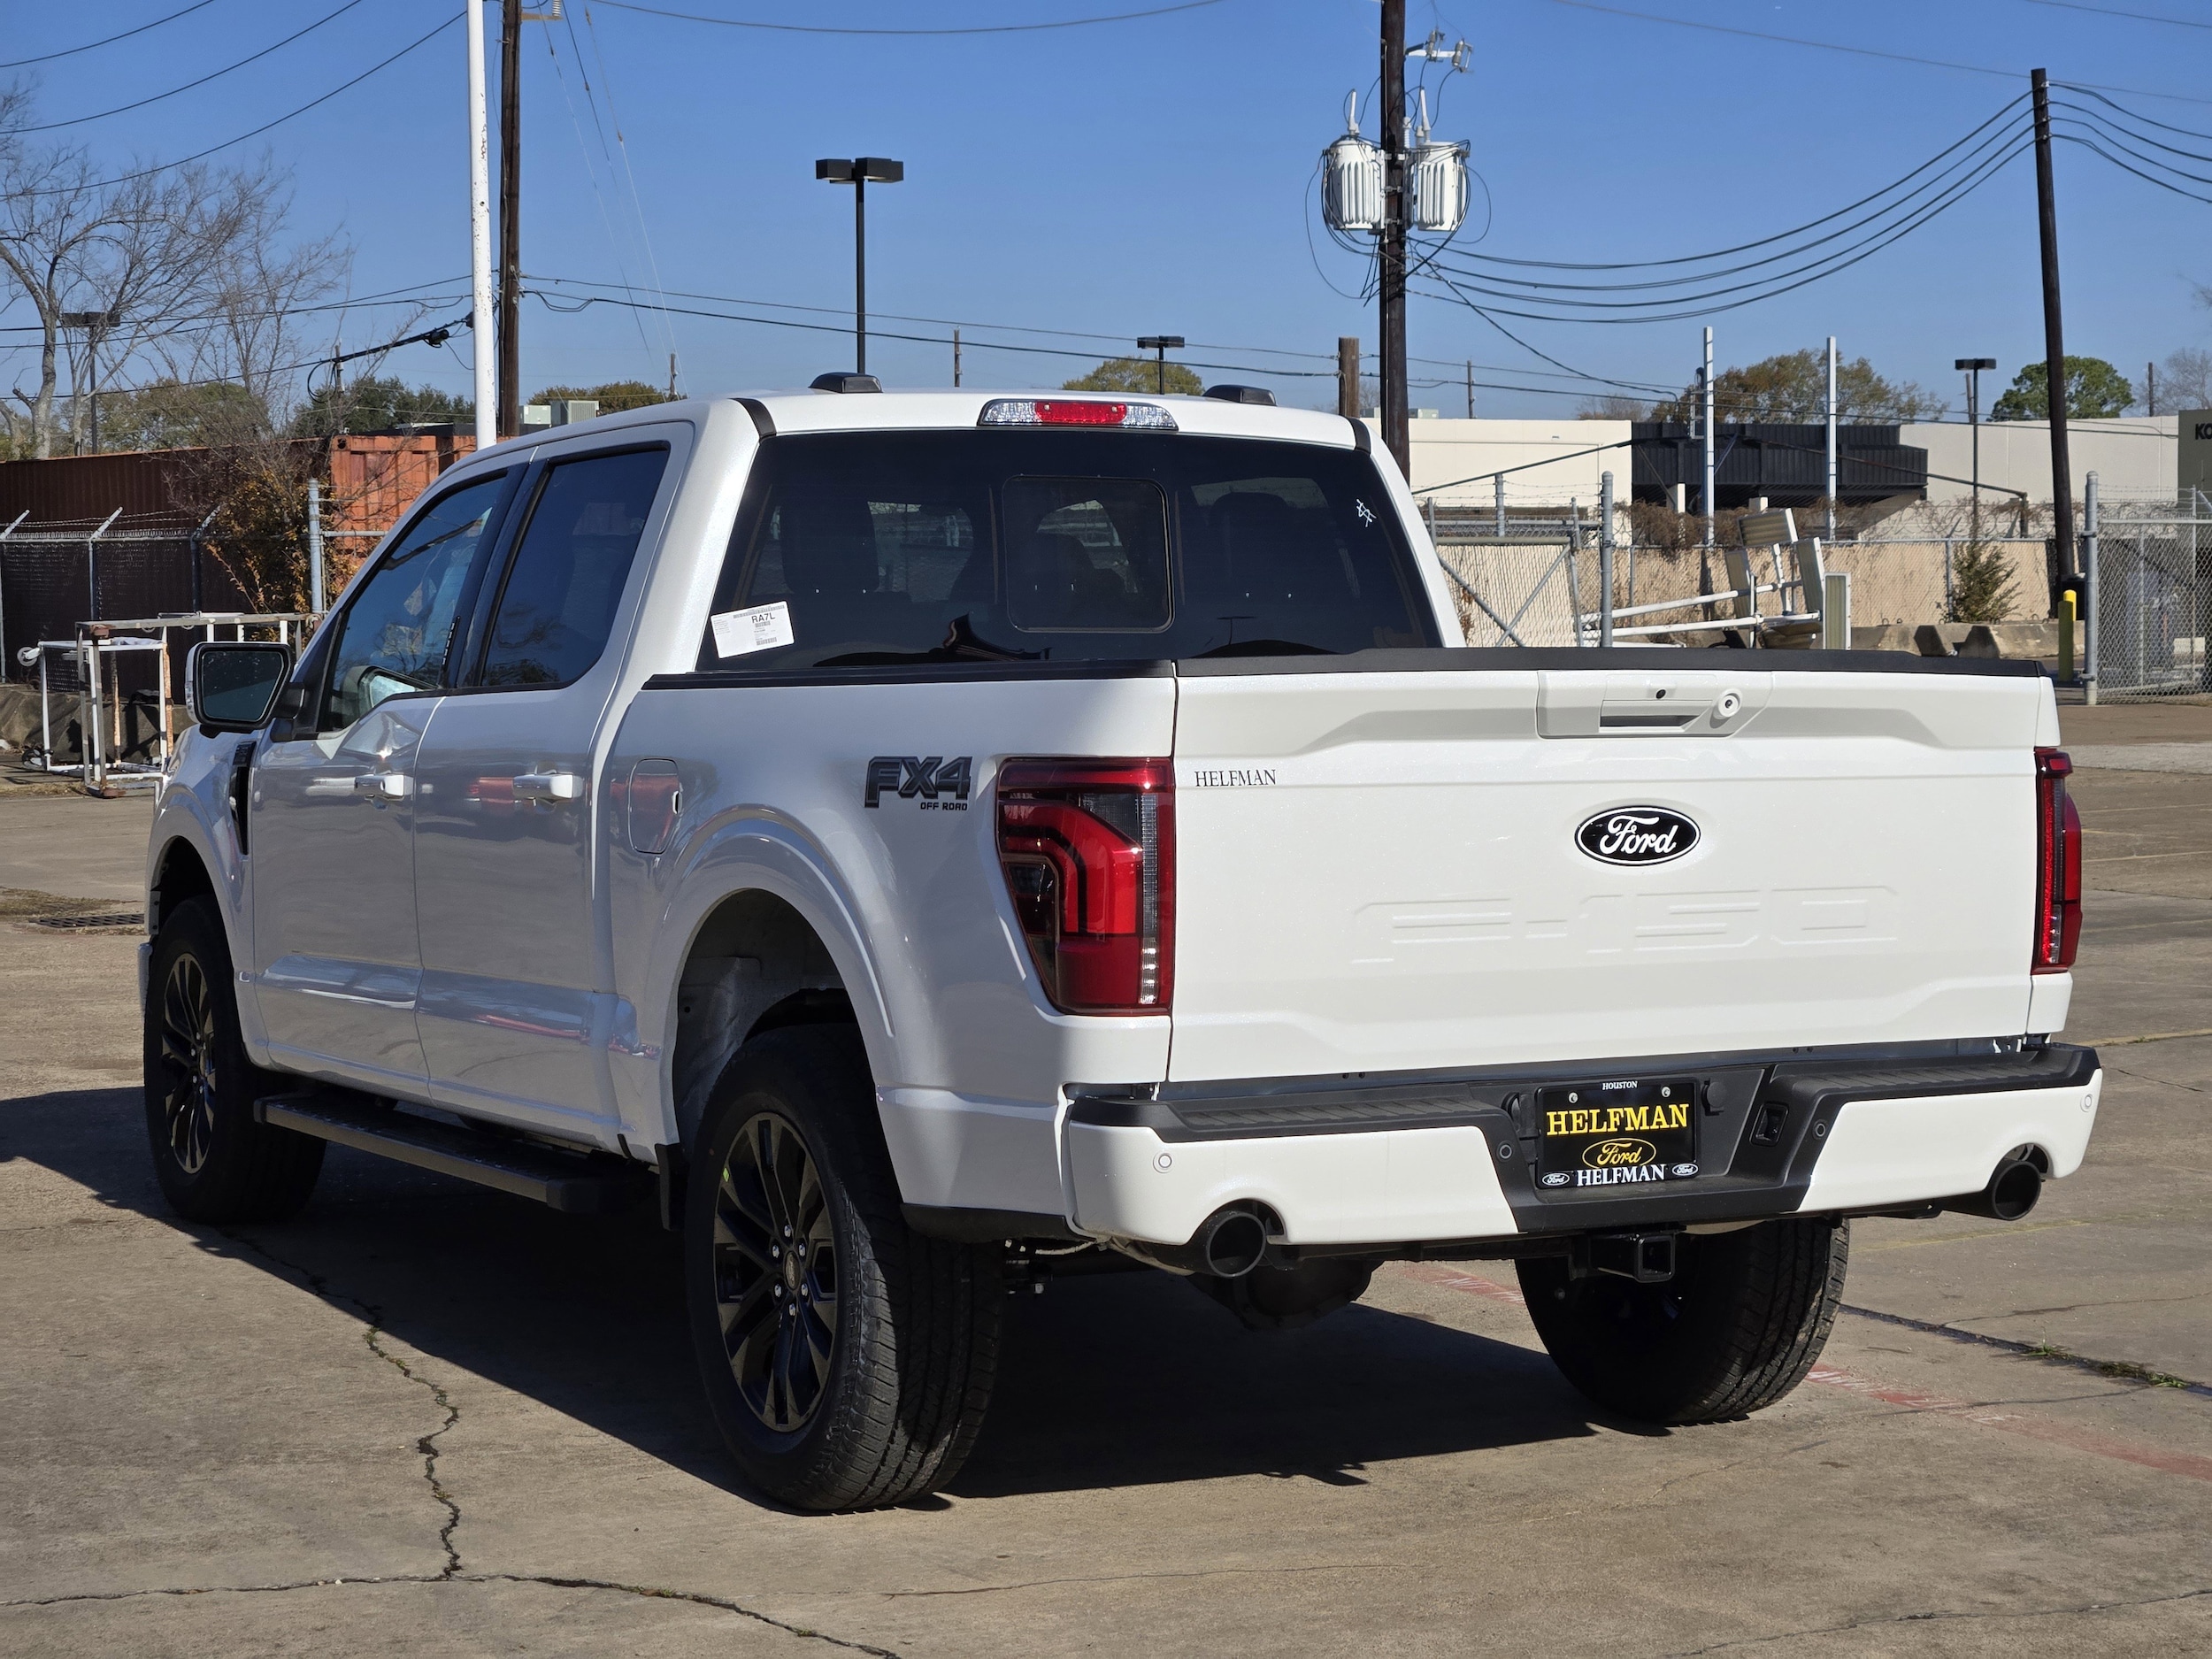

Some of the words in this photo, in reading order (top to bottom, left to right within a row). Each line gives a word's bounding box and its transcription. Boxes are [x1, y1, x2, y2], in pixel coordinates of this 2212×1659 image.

[751, 612, 776, 623] RA7L
[864, 756, 972, 809] FX4
[1194, 769, 1276, 787] HELFMAN
[1599, 815, 1679, 855] Ford
[1602, 1080, 1638, 1091] HOUSTON
[1547, 1103, 1689, 1136] HELFMAN
[1596, 1142, 1643, 1165] Ford
[1547, 1174, 1567, 1185] Ford
[1576, 1164, 1667, 1187] HELFMAN
[1676, 1164, 1694, 1175] Ford
